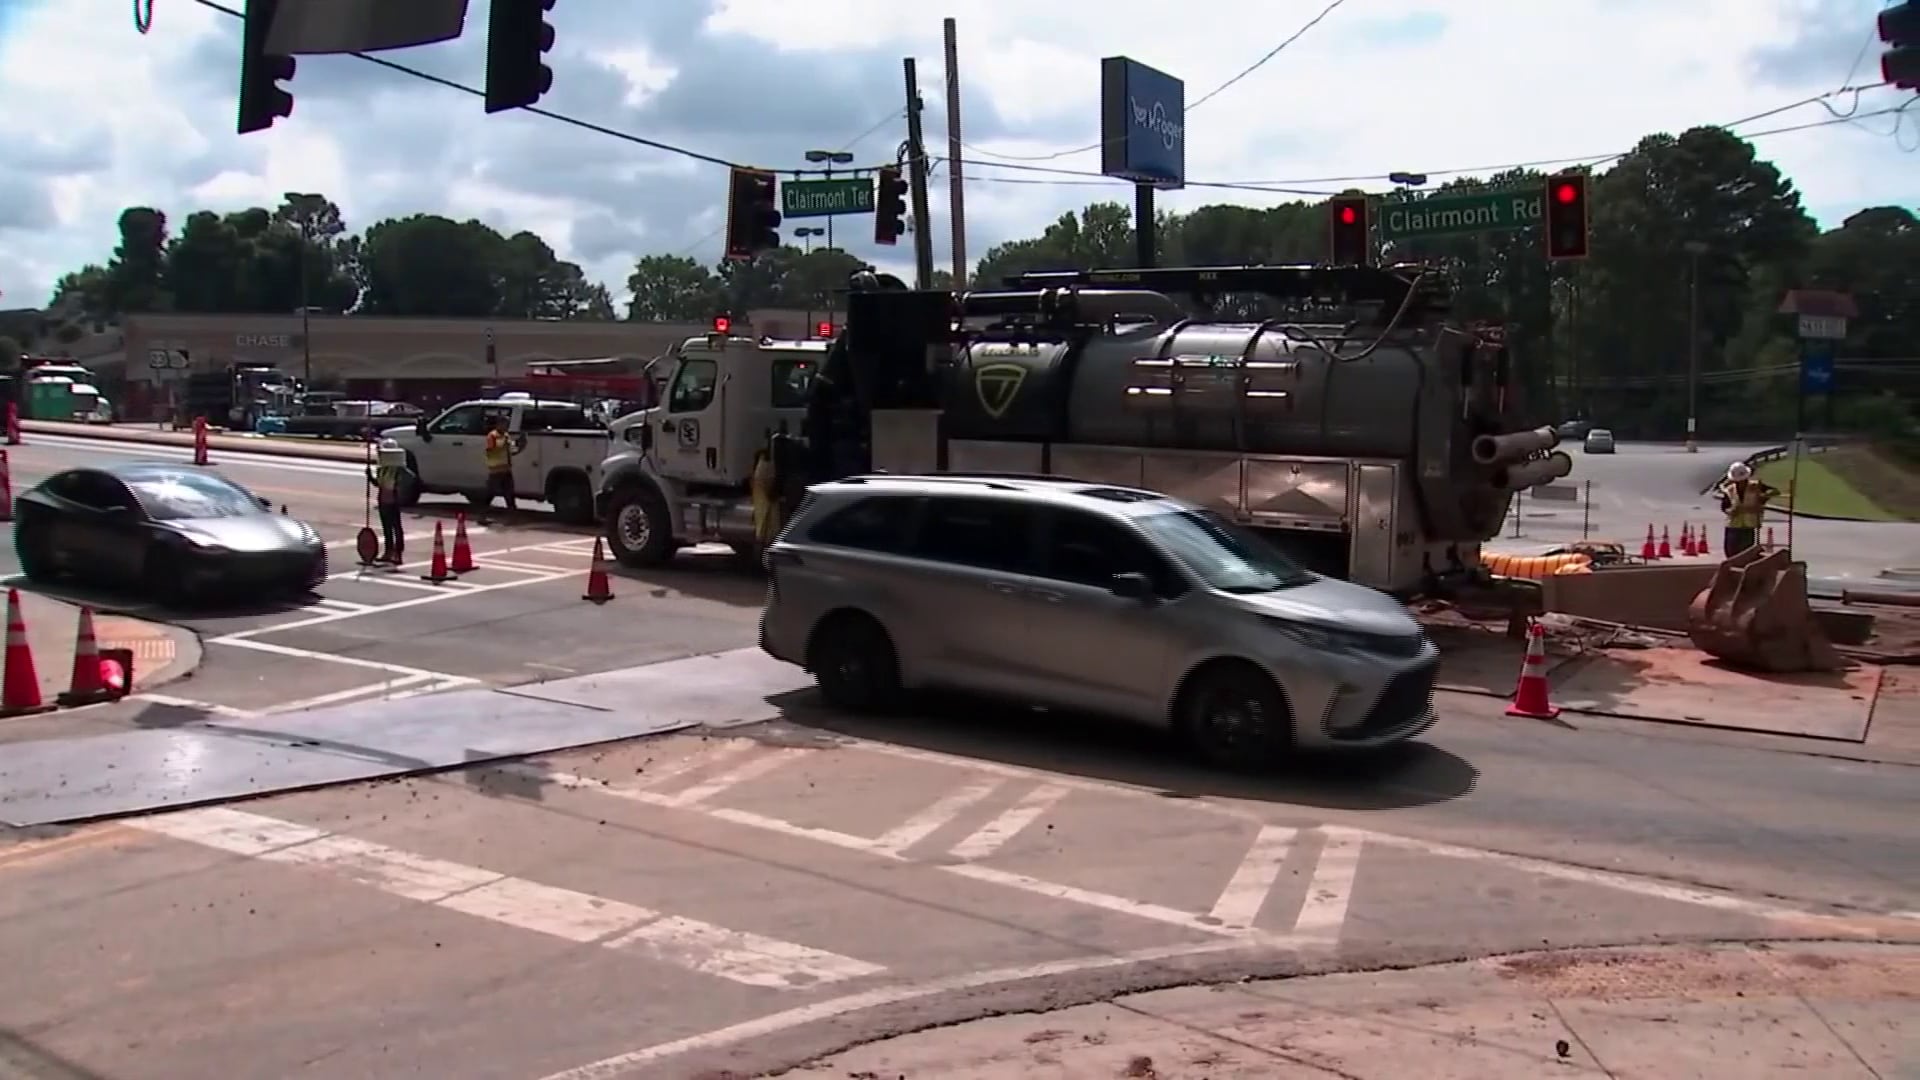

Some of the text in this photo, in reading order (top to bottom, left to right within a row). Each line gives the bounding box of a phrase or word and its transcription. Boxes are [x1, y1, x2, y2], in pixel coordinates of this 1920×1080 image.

[786, 186, 869, 209] Clairmont Ter
[1390, 197, 1541, 232] Clairmont Rd
[236, 335, 288, 347] CHASE
